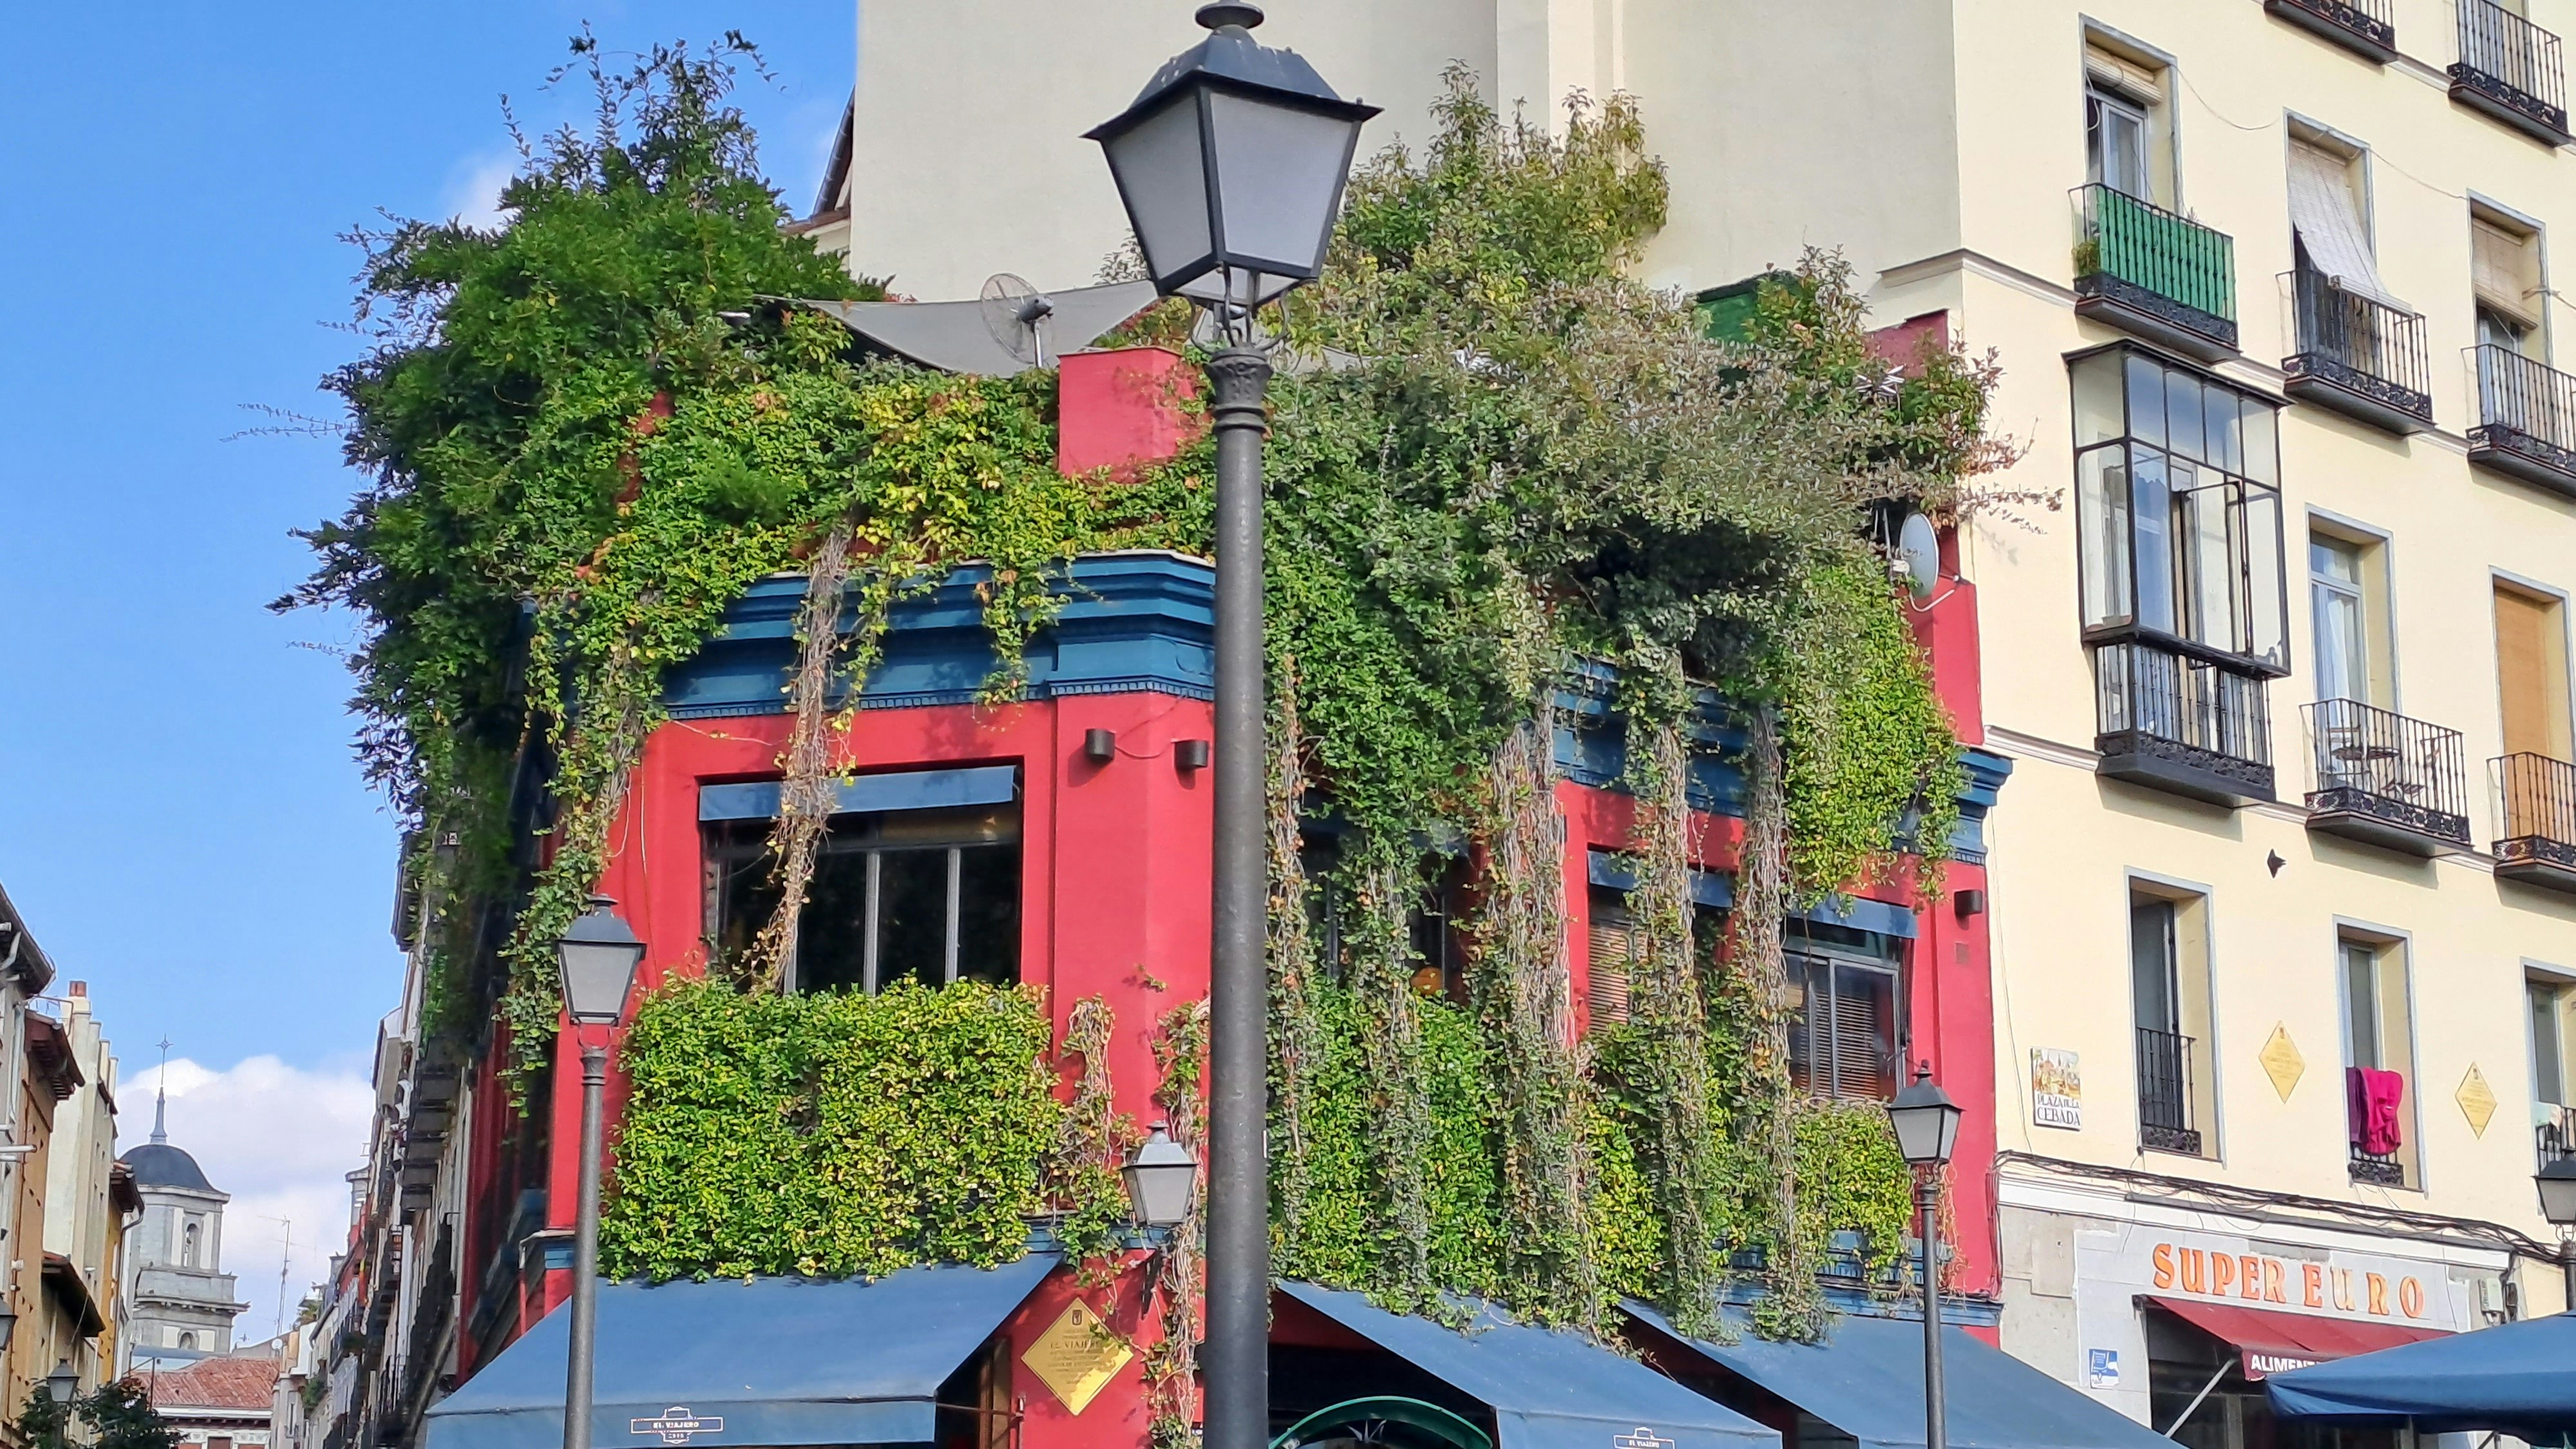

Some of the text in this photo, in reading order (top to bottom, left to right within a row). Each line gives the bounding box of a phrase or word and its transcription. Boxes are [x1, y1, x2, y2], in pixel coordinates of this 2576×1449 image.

[2037, 1093, 2063, 1108] PLAZA
[2037, 1106, 2081, 1126] CEBADA
[2152, 1243, 2425, 1319] SUPER EURO
[2251, 1354, 2322, 1372] ALIMEN
